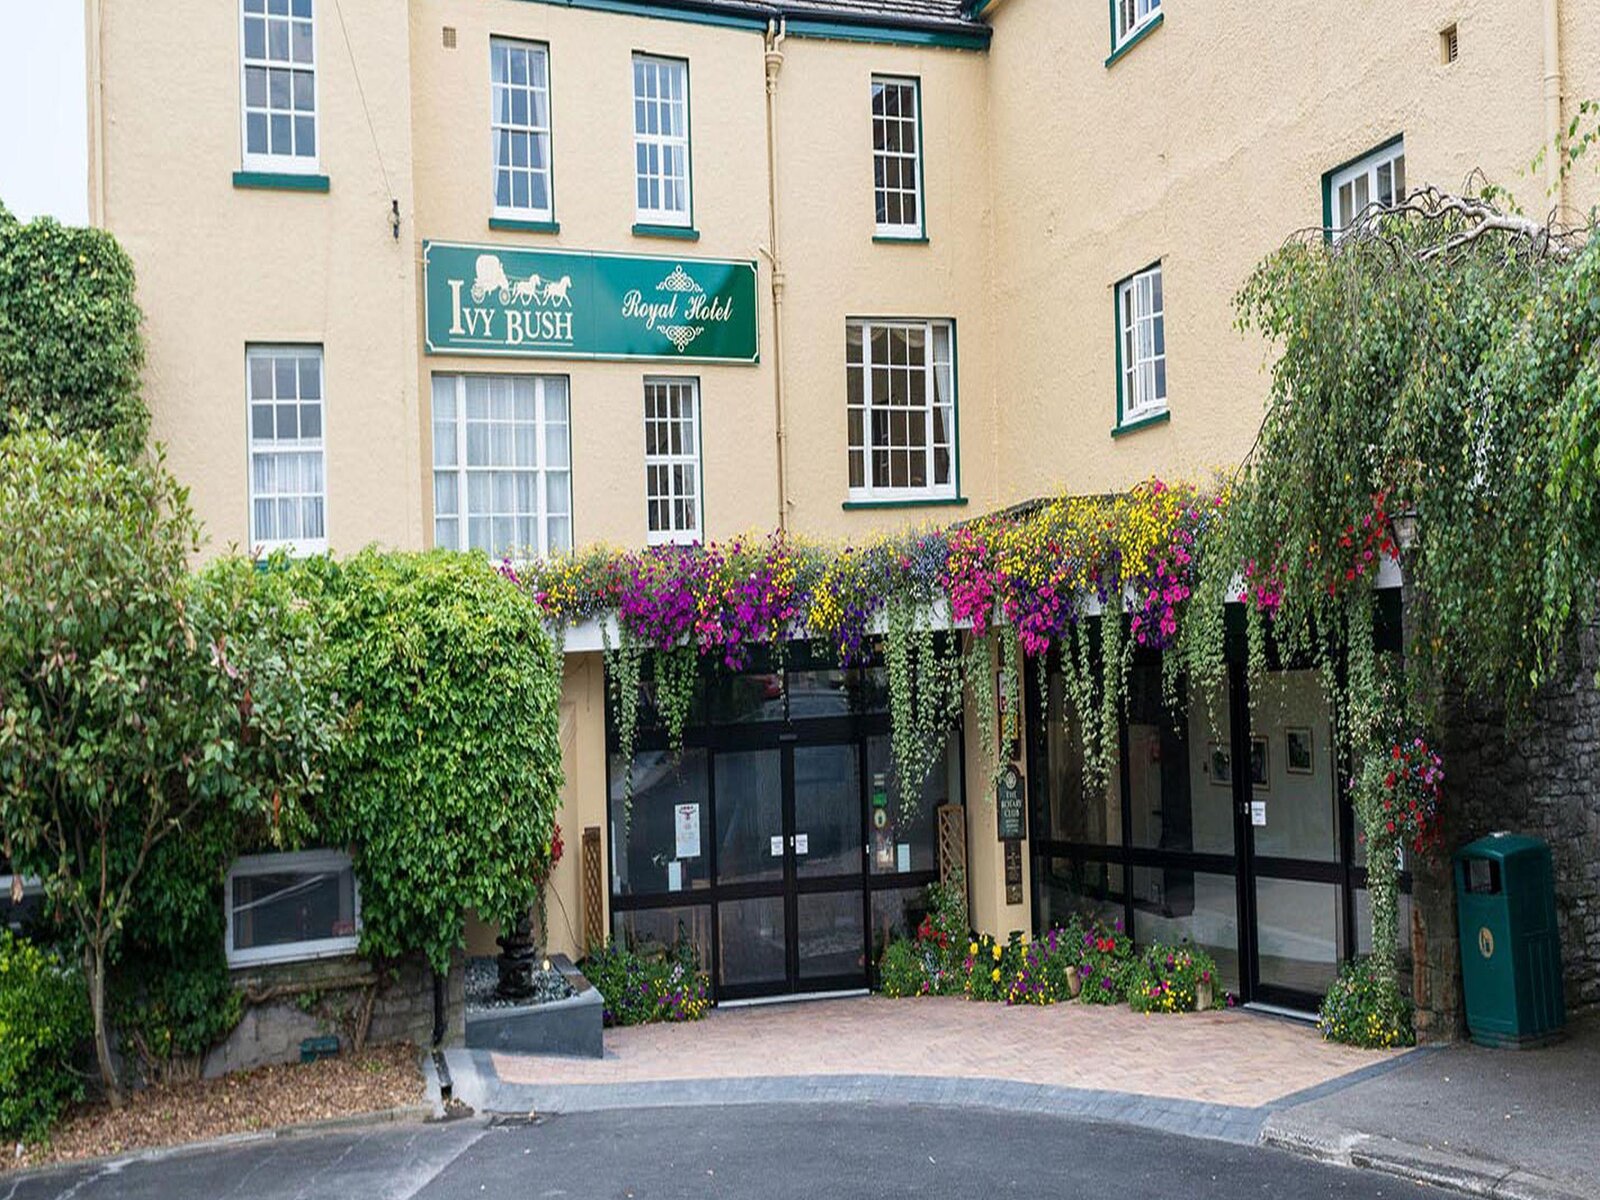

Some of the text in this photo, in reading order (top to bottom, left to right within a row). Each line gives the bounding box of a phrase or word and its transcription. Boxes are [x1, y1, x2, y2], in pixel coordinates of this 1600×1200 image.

[505, 310, 573, 344] BUSH
[622, 290, 733, 329] Royal Hotel
